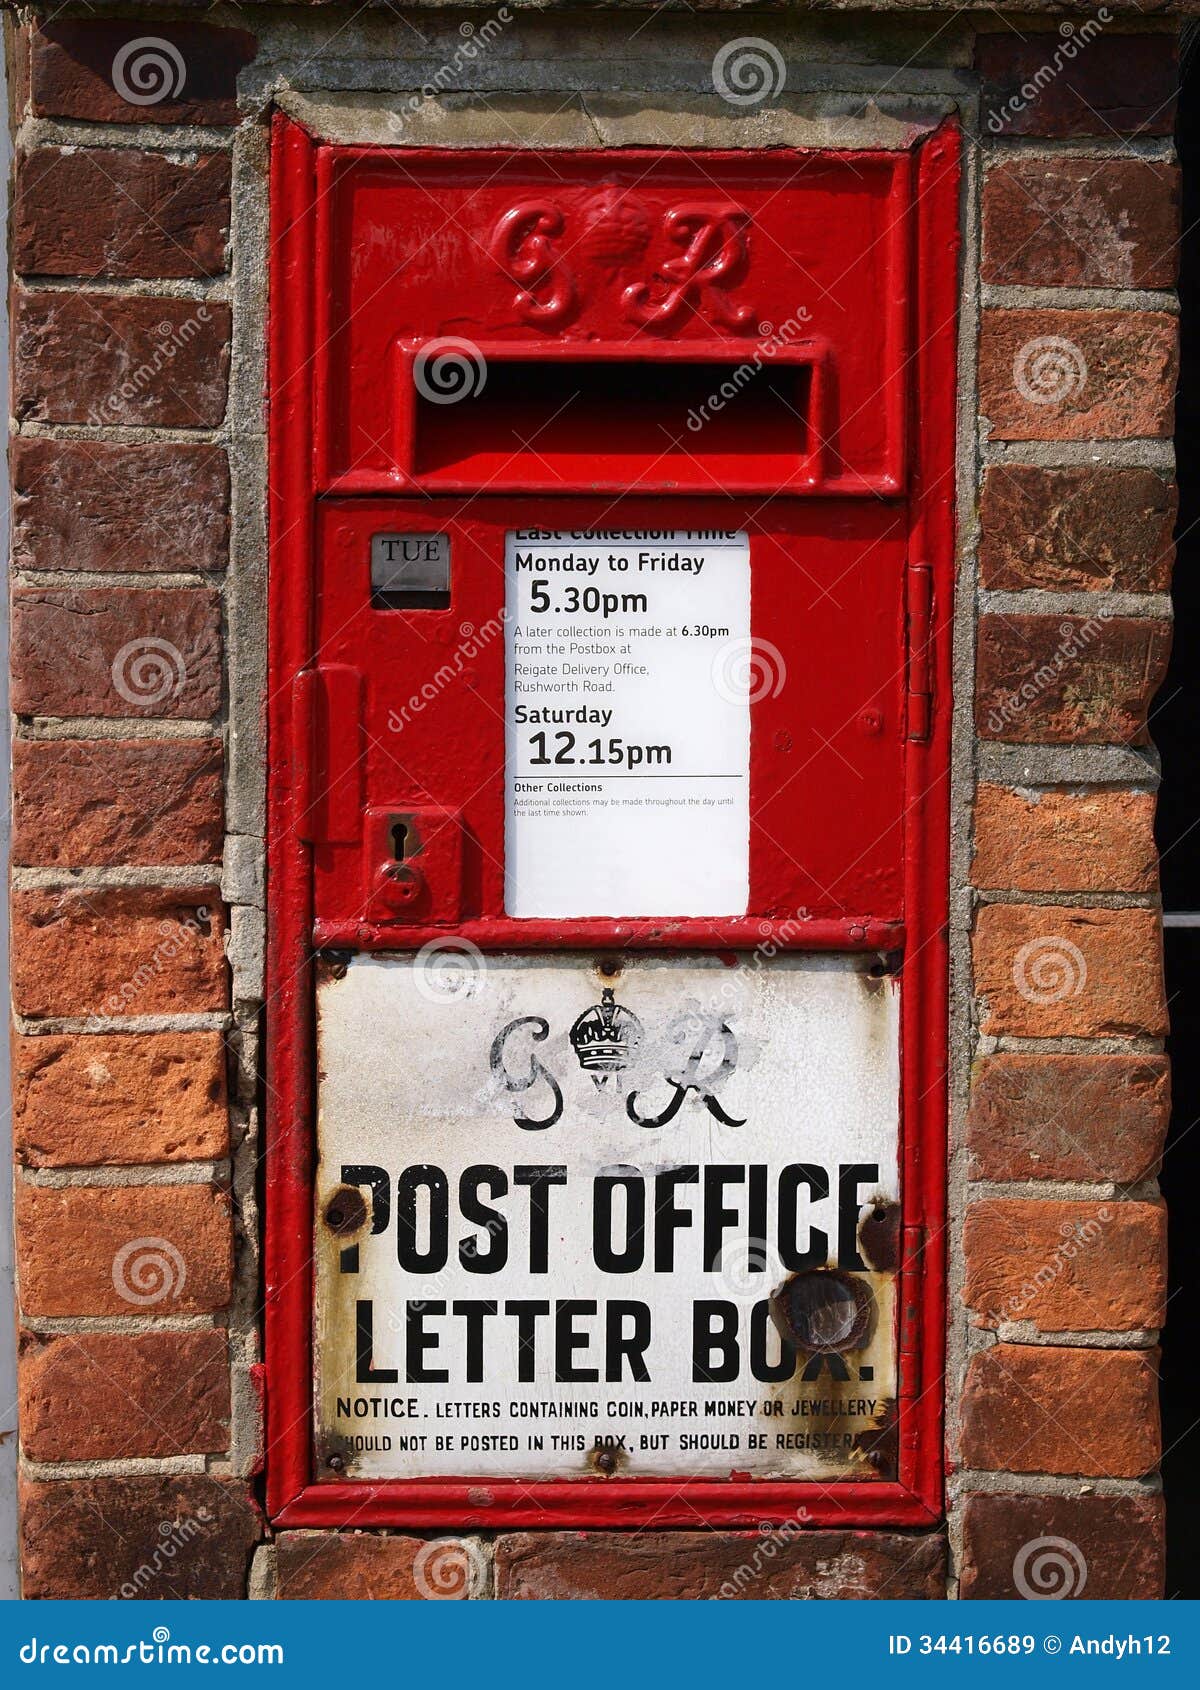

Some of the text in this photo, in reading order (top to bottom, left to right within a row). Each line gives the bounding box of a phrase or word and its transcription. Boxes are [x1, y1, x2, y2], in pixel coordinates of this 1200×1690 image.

[381, 539, 441, 562] TUE
[515, 552, 705, 576] Monday to Friday
[530, 579, 648, 619] 5.30pm
[514, 625, 730, 638] A later collection is made at 6.30pm
[514, 643, 632, 655] from the Postbox at
[514, 663, 558, 678] Reigate
[562, 662, 610, 678] Delivery
[514, 680, 579, 693] Rushworth
[514, 704, 613, 727] Saturday
[528, 730, 672, 770] 12.15pm
[514, 782, 603, 793] Other Collections
[514, 797, 734, 808] Additional collections may be made throughout the day until
[514, 809, 526, 817] the
[528, 809, 542, 817] last
[543, 809, 561, 817] time
[340, 1164, 567, 1274] POST
[356, 1300, 651, 1384] LETTER
[337, 1397, 429, 1418] NOTICE.
[436, 1401, 501, 1418] LETTERS
[509, 1401, 599, 1418] CONTAINING
[704, 1400, 757, 1417] MONEY
[763, 1400, 784, 1417] OR
[791, 1399, 878, 1417] JEWELLERY
[337, 1435, 392, 1452] HOULD
[400, 1435, 428, 1451] NOT
[435, 1435, 455, 1451] BE
[460, 1435, 519, 1451] POSTED
[528, 1435, 544, 1451] IN
[550, 1434, 585, 1451] THIS
[640, 1434, 670, 1450] BUT
[679, 1434, 740, 1450] SHOULD
[748, 1434, 768, 1449] BE
